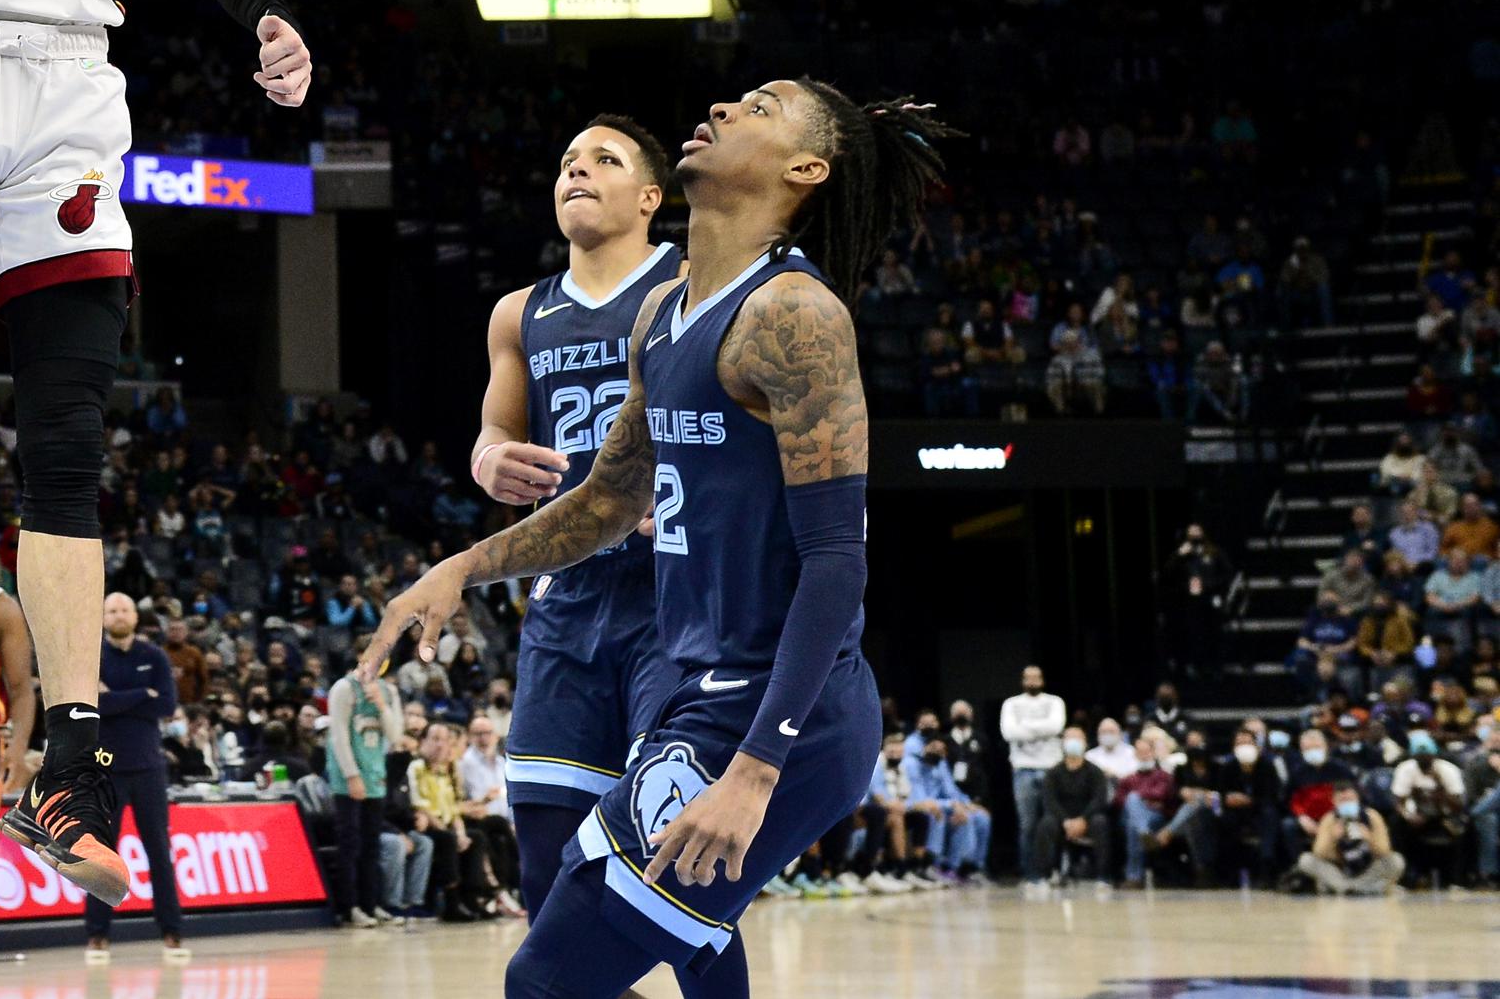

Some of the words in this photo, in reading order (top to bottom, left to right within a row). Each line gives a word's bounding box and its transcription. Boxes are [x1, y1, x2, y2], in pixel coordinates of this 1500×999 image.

[133, 156, 250, 208] FedEx
[529, 336, 632, 381] GRIZZLI
[550, 379, 631, 455] 22
